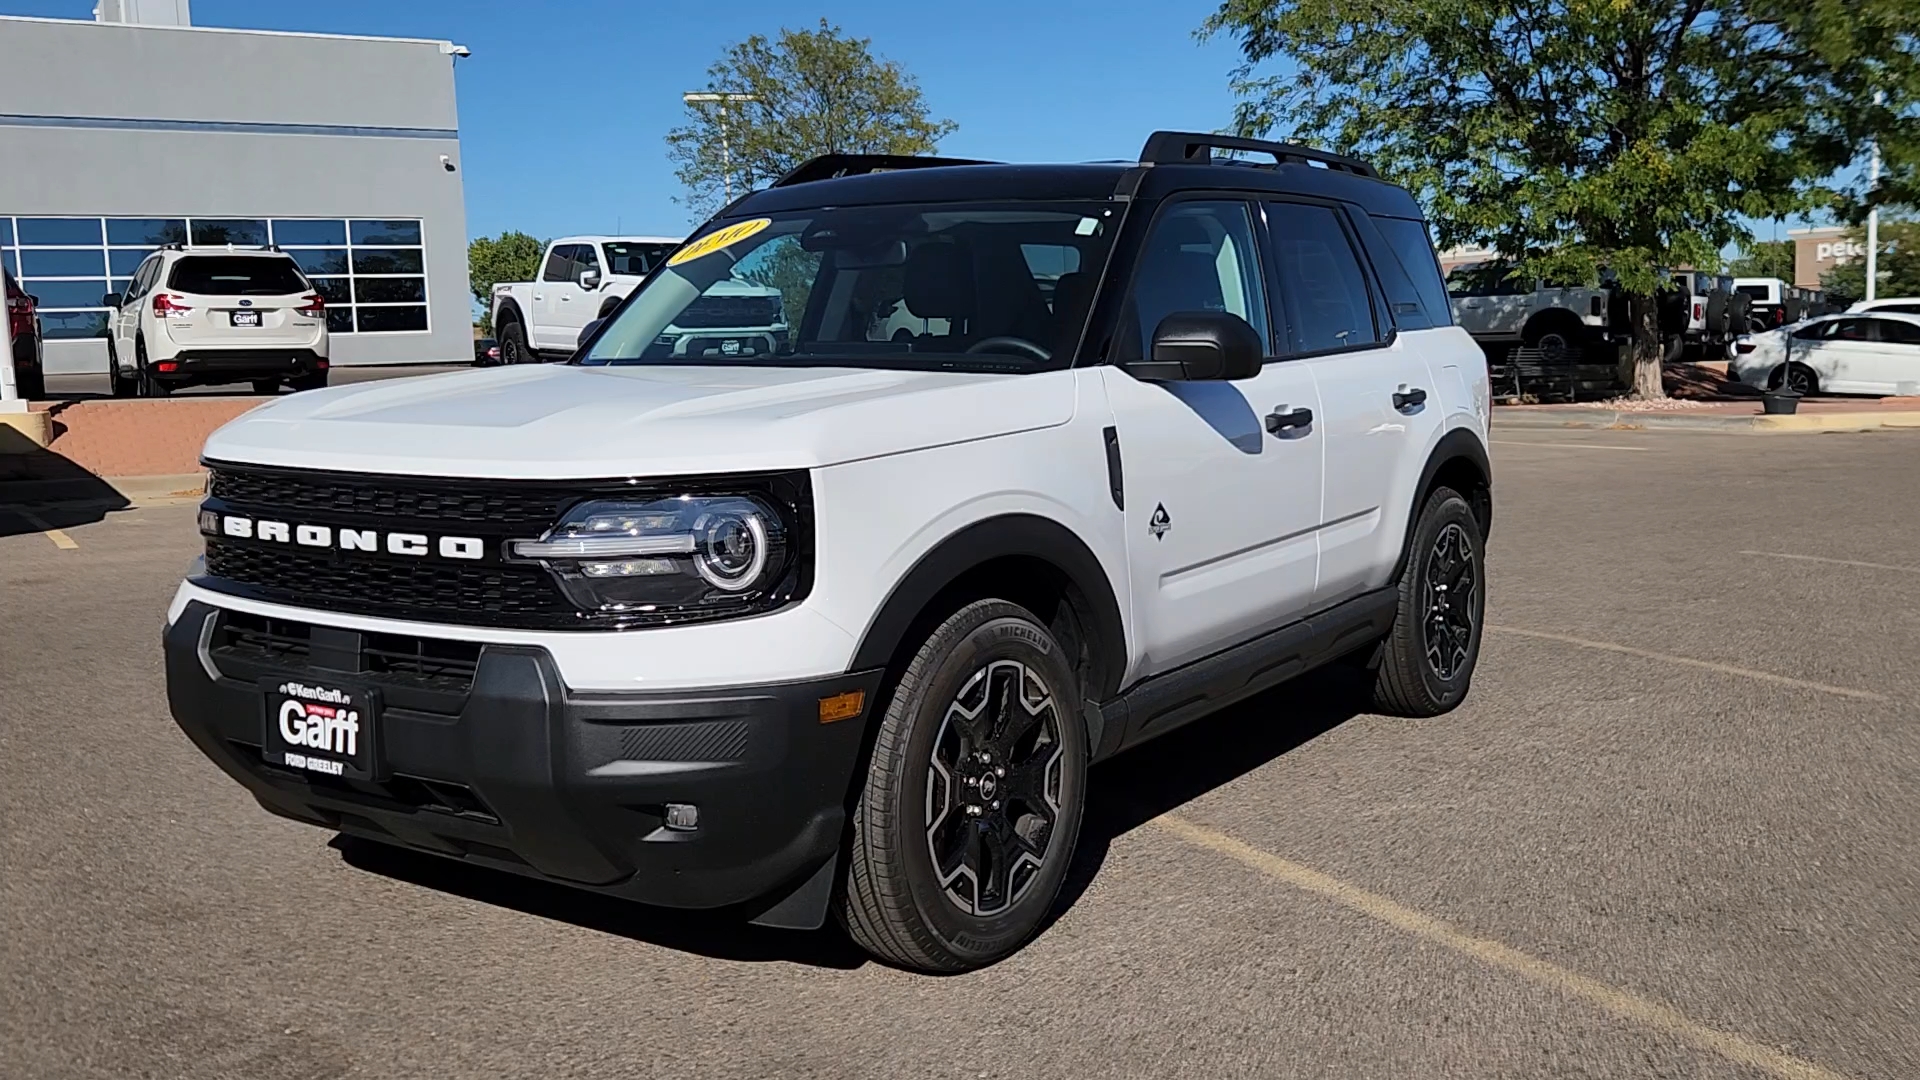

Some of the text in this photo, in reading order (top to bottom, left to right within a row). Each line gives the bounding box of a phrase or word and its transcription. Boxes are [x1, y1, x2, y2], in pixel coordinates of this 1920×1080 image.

[223, 515, 484, 560] BRONCO
[1000, 627, 1048, 650] MICHELIN
[279, 699, 359, 755] Garff
